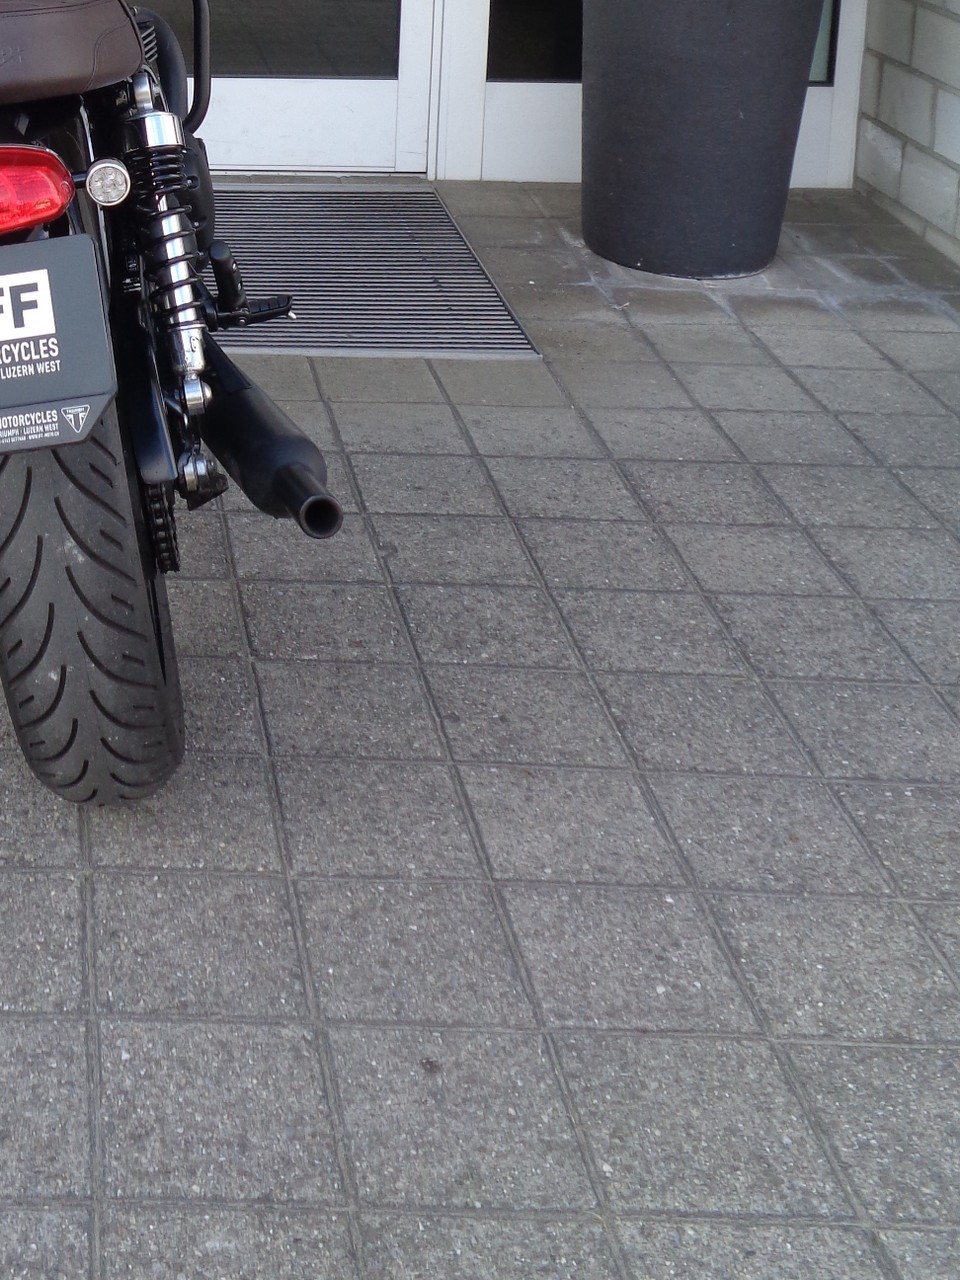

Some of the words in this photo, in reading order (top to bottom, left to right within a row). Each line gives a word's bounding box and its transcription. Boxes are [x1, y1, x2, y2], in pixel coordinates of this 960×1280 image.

[0, 362, 35, 380] LUZERN
[36, 359, 61, 375] WEST
[23, 425, 44, 435] LUZERN
[44, 423, 59, 432] WEST
